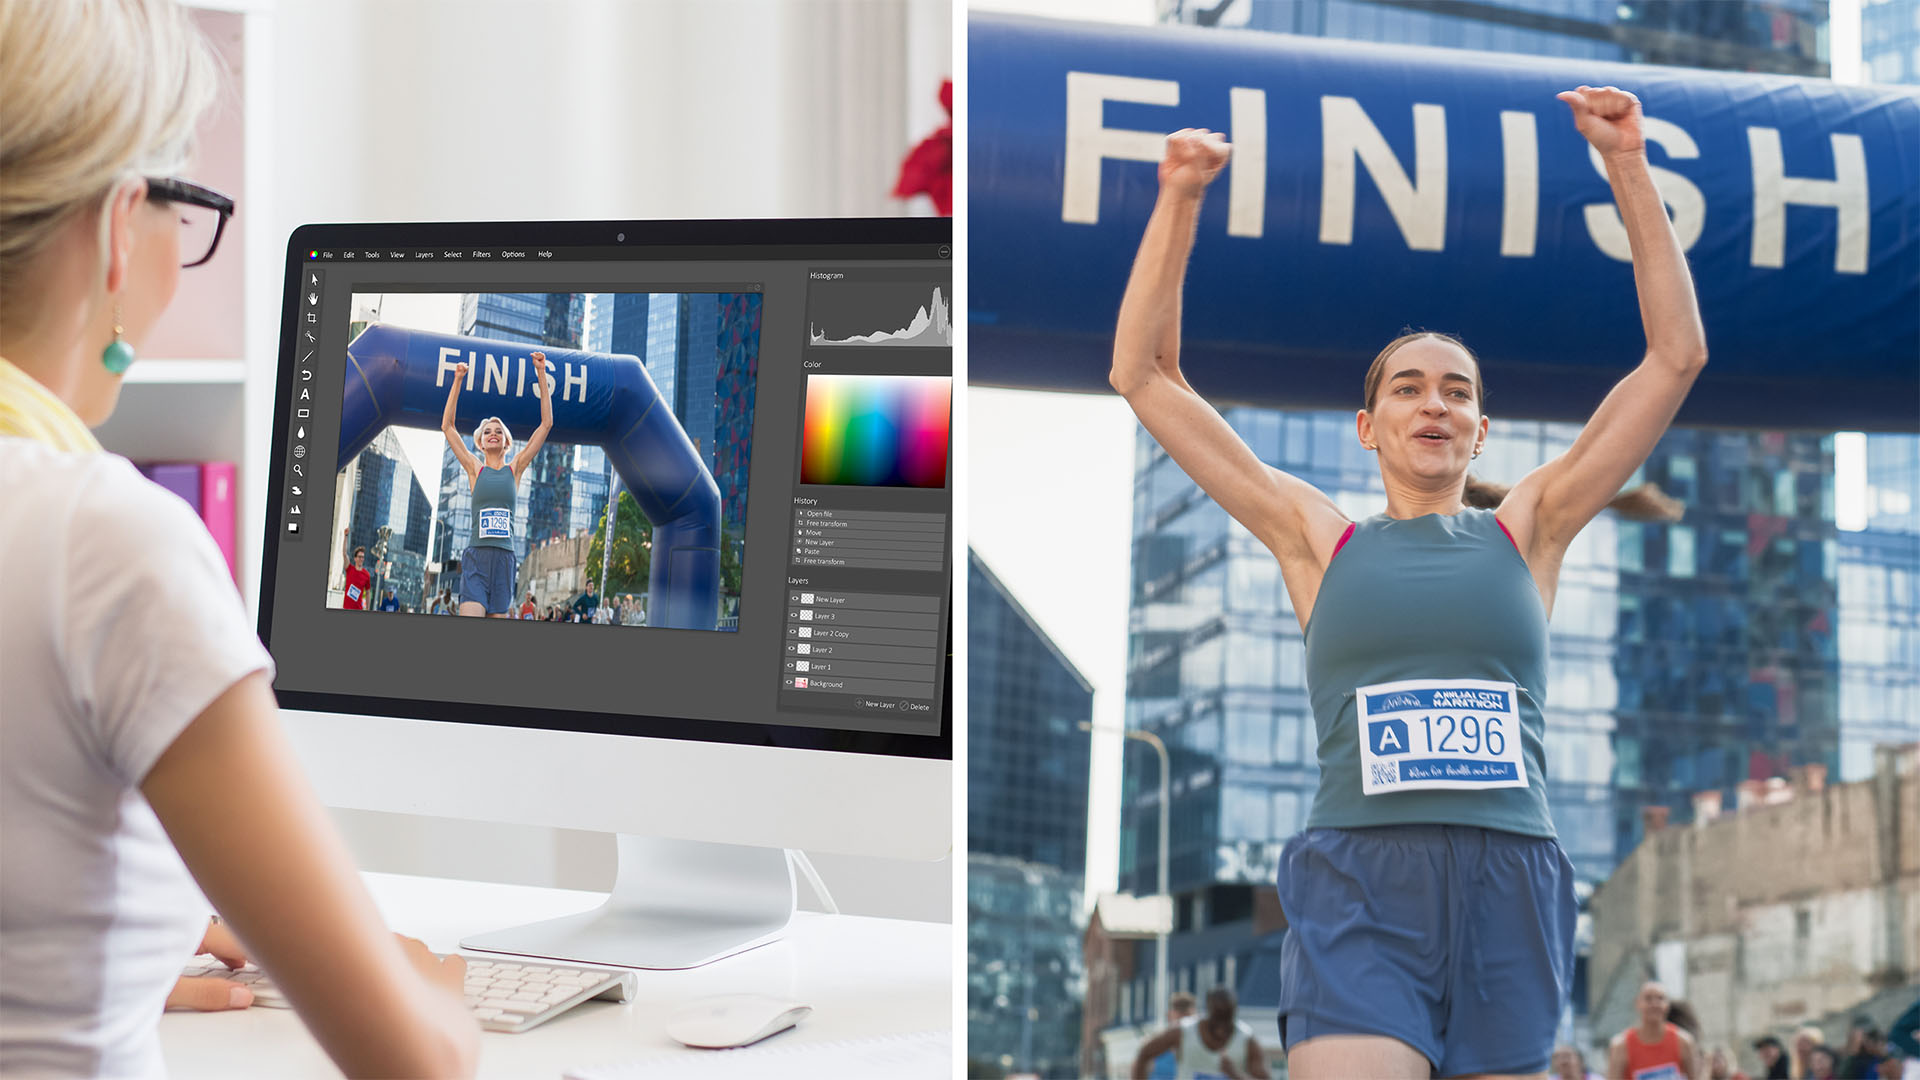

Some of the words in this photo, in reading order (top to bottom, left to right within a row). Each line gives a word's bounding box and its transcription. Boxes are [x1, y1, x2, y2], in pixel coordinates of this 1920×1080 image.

[1061, 70, 1870, 275] FINISH
[322, 251, 333, 259] File
[343, 251, 355, 259] Edit
[364, 251, 380, 259] Tools
[390, 251, 405, 259] View
[415, 251, 434, 260] Layers
[443, 250, 462, 259] Select
[472, 250, 491, 258] Filters
[501, 250, 525, 259] Options
[538, 250, 552, 259] Help
[810, 272, 844, 281] Histogram
[803, 360, 822, 369] Color
[436, 346, 588, 403] FINISH
[794, 497, 818, 506] History
[807, 510, 822, 518] Open
[490, 517, 508, 529] 1296
[805, 538, 817, 546] New
[818, 539, 834, 547] Layer
[788, 577, 809, 585] Layers
[828, 596, 845, 604] Layer
[814, 612, 829, 621] Layer
[813, 629, 828, 638] Layer
[834, 630, 849, 639] Copy
[812, 646, 827, 655] Layer
[811, 663, 826, 671] Layer
[810, 680, 843, 688] Background
[878, 701, 895, 710] Layer
[910, 703, 930, 711] Delete
[1379, 725, 1402, 751] A
[1419, 715, 1505, 756] 1296
